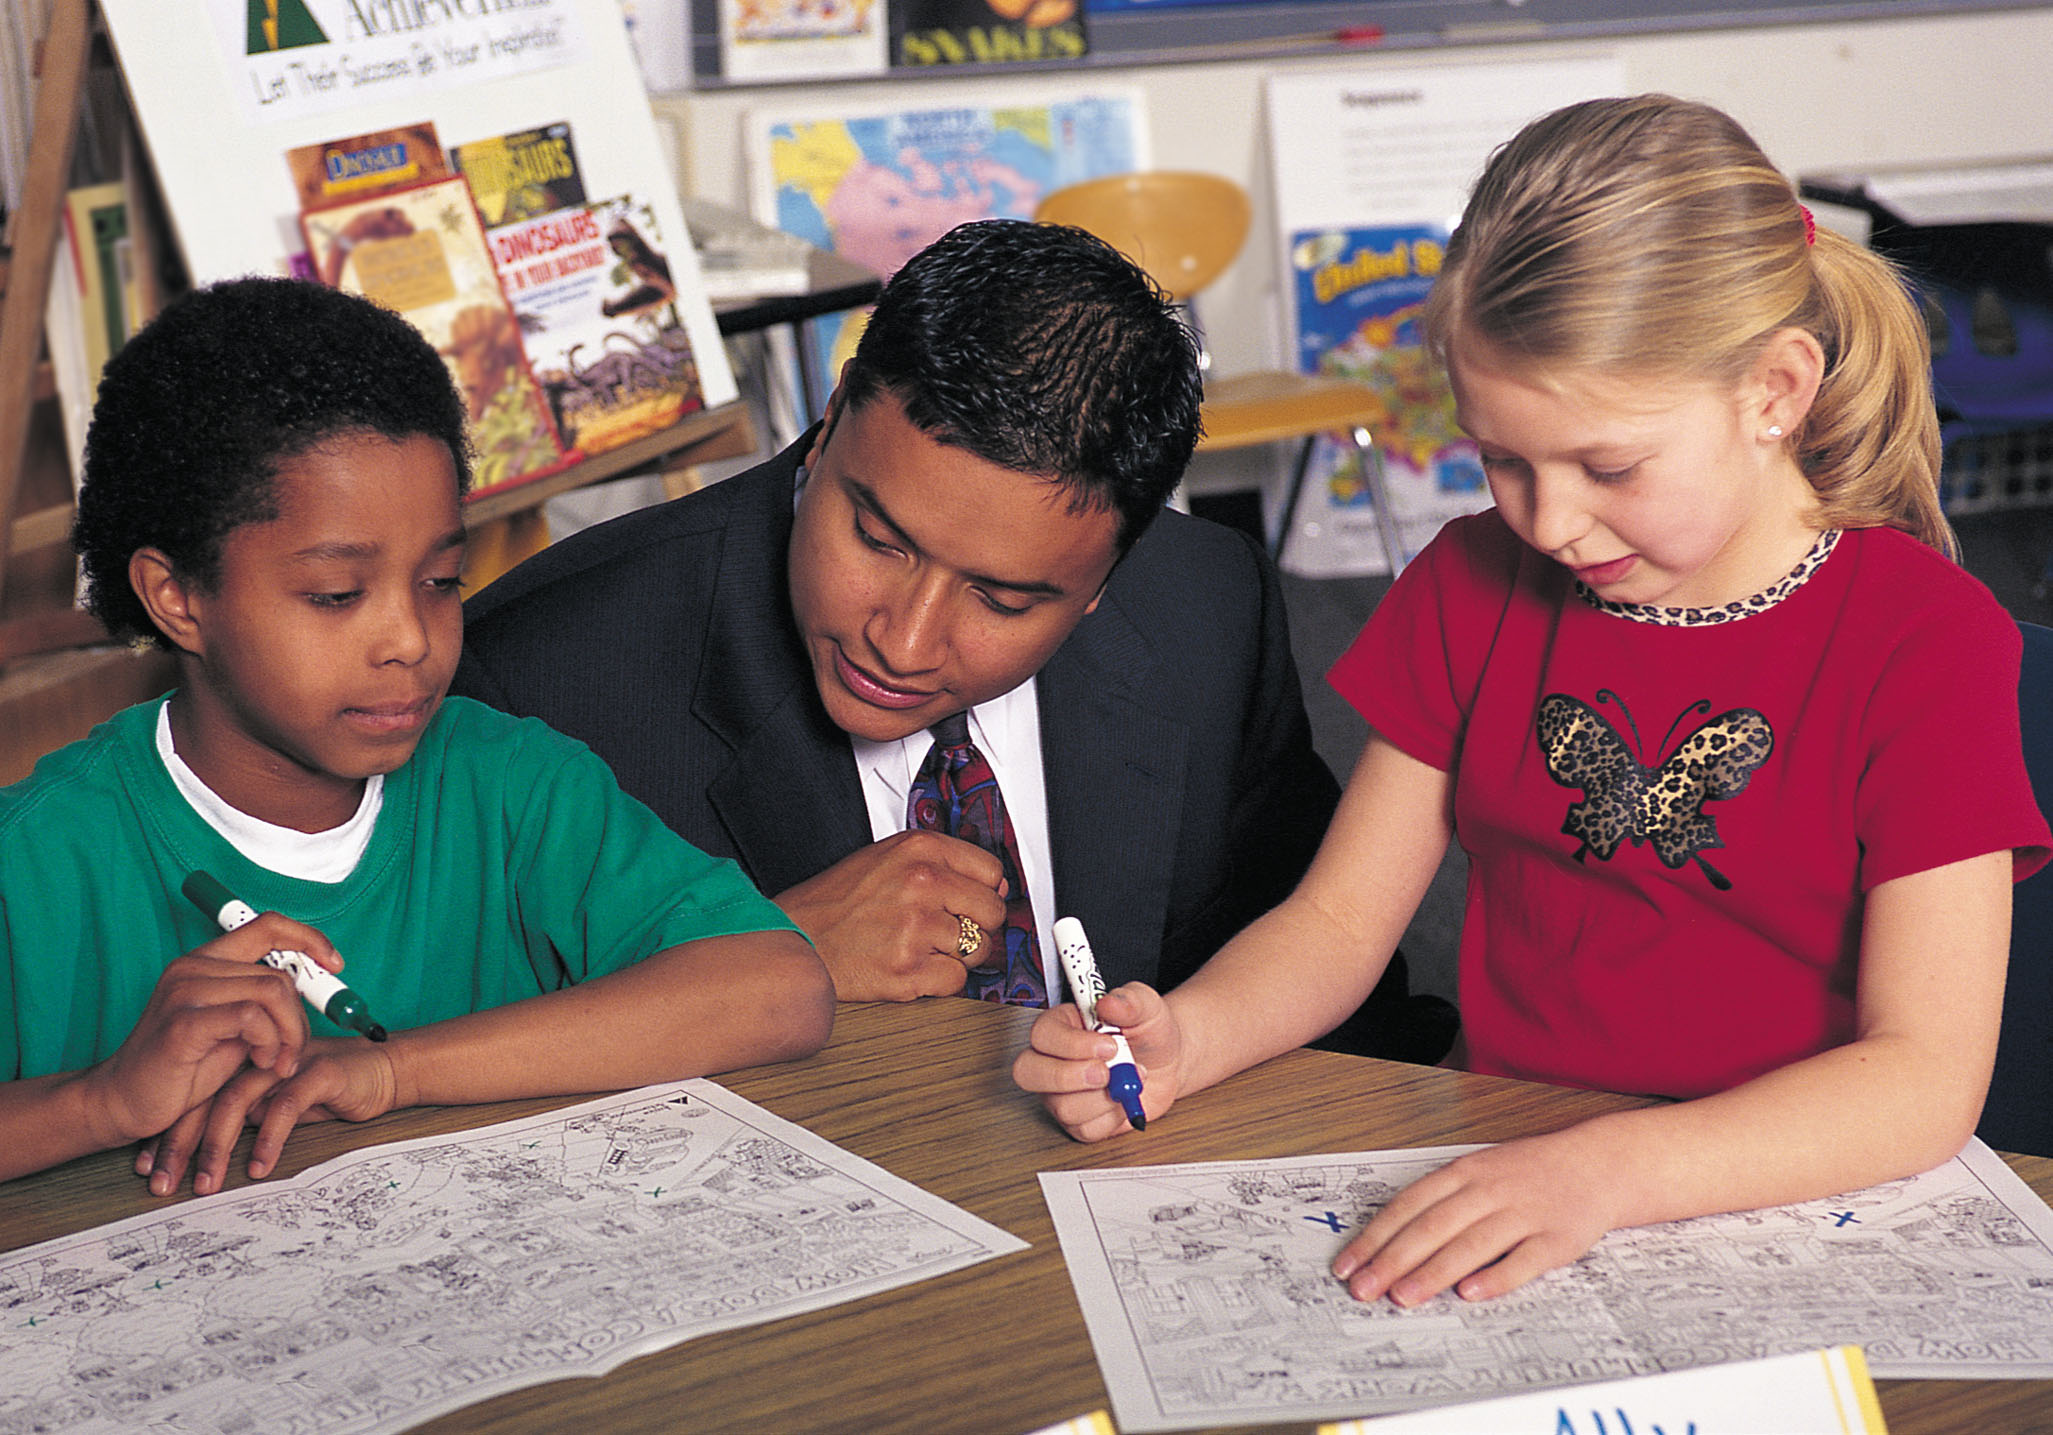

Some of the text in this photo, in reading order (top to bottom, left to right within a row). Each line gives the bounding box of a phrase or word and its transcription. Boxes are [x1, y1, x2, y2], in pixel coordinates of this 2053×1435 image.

[249, 68, 288, 106] Let
[434, 42, 480, 67] Your
[497, 207, 600, 264] DINOSAURS
[1313, 239, 1409, 304] United
[1915, 1333, 2040, 1362] HOW
